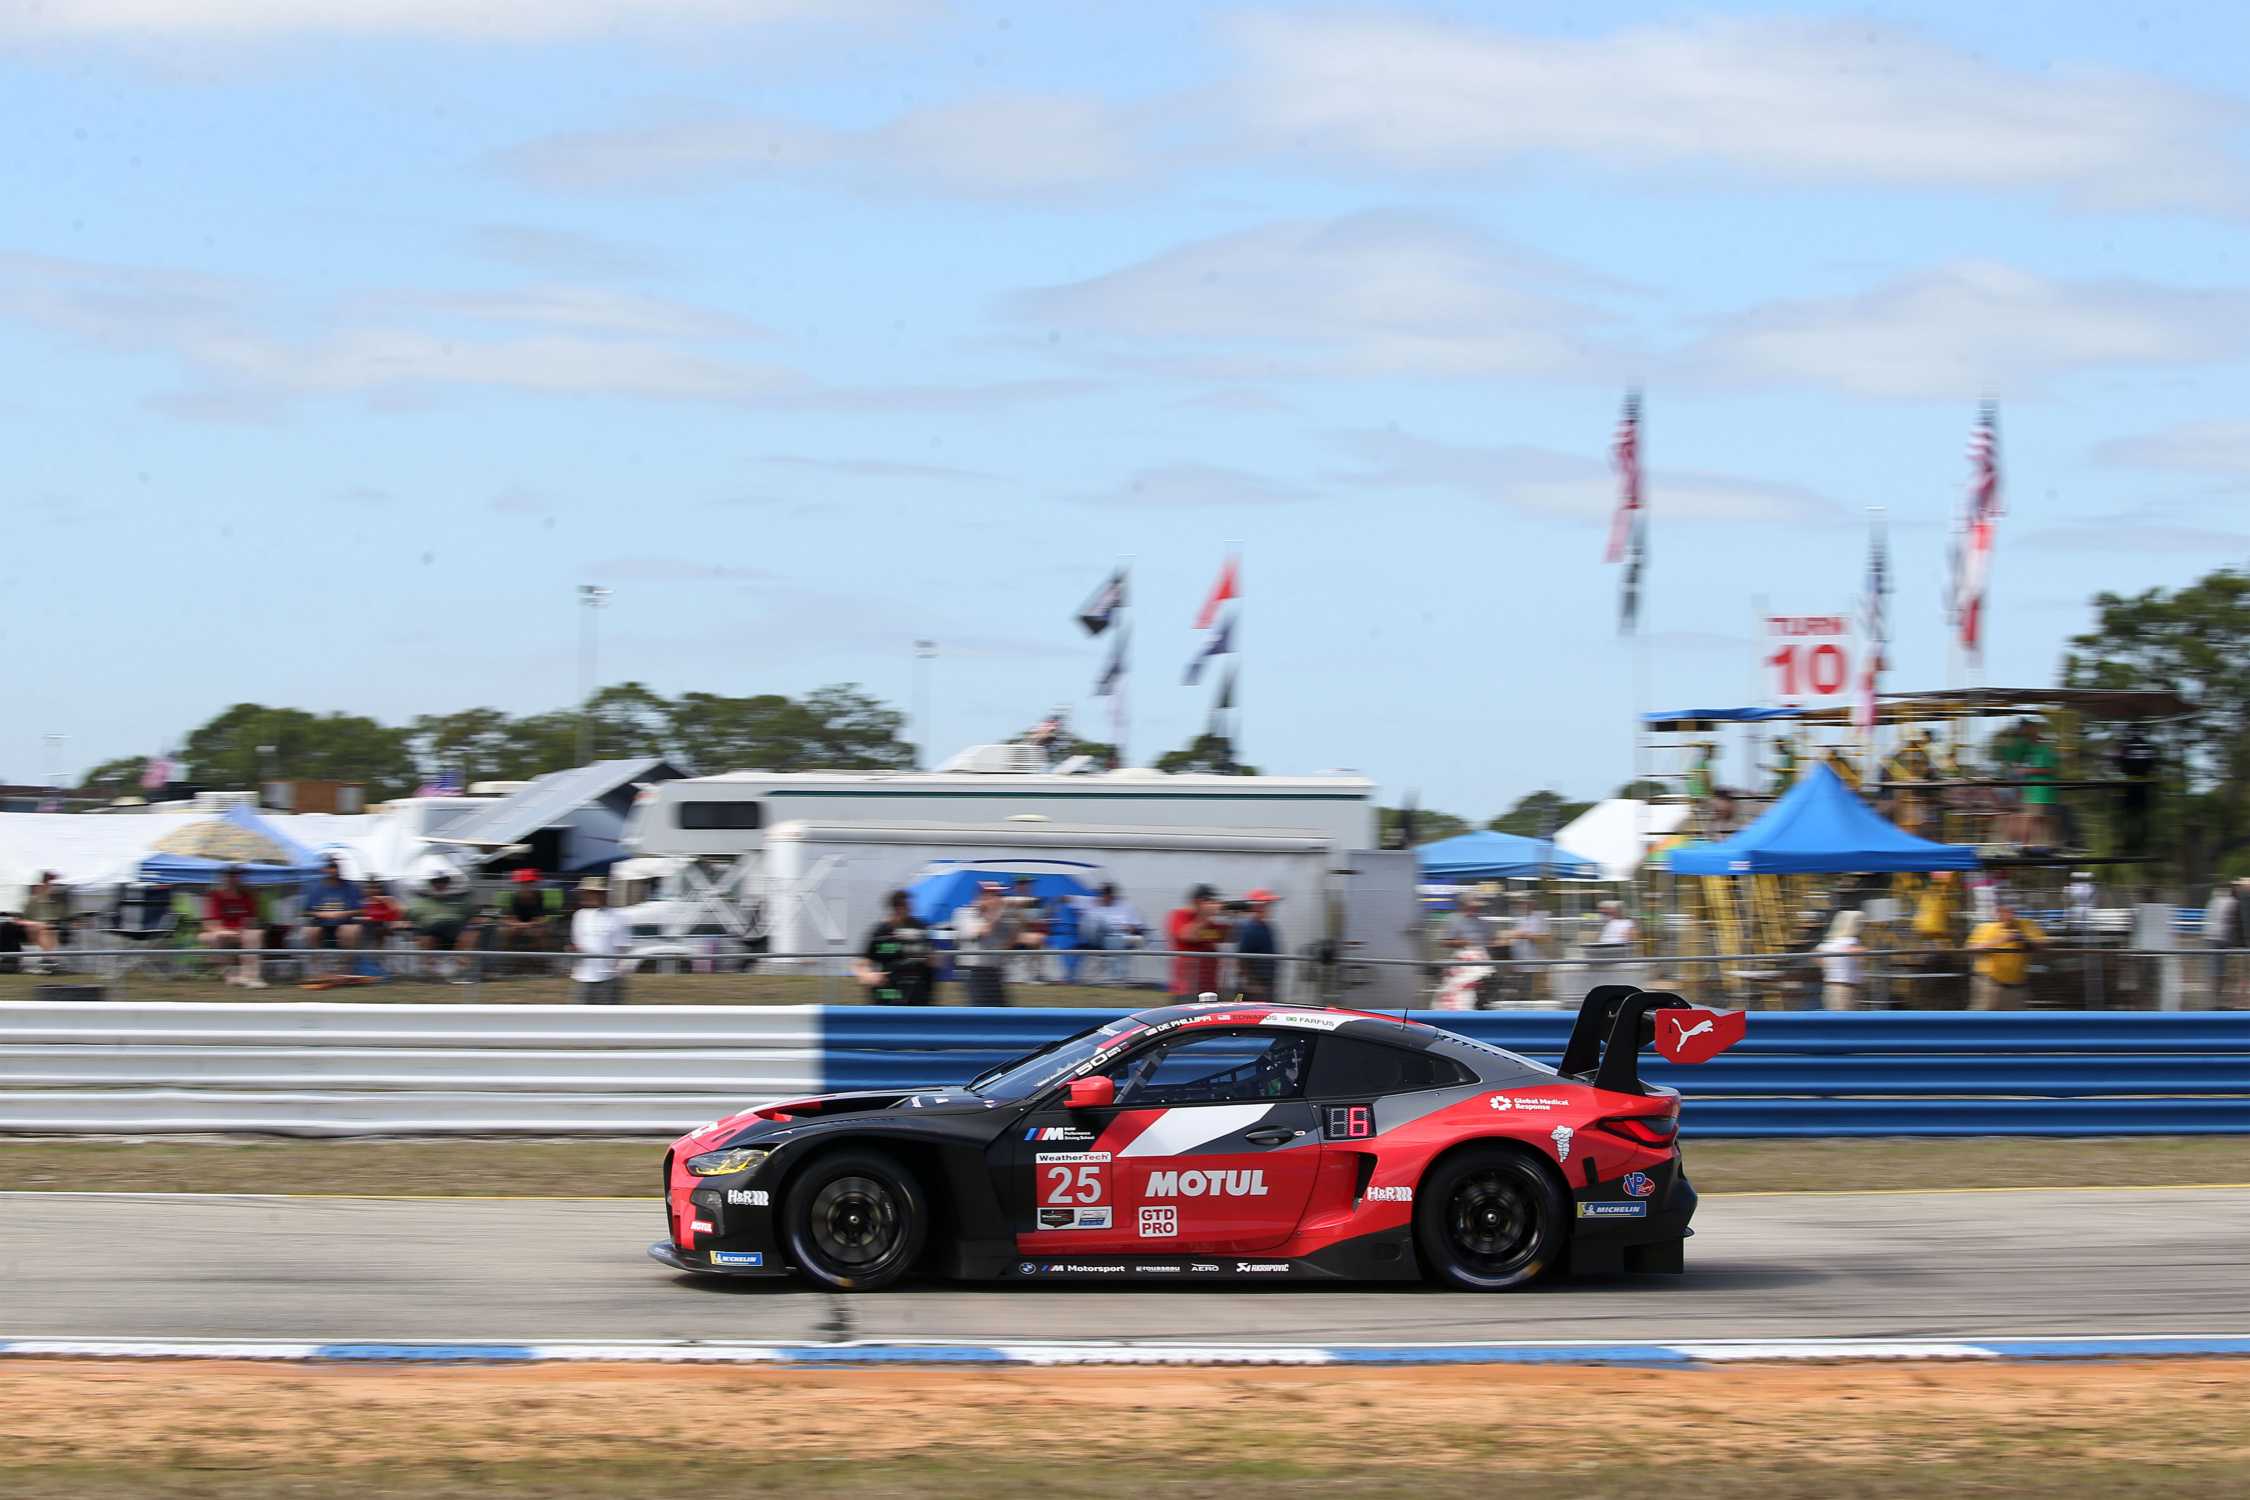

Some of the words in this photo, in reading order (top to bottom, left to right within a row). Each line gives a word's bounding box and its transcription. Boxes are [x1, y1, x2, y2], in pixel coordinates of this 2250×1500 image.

[1768, 617, 1847, 635] TURN
[1767, 644, 1848, 694] 10
[1158, 1023, 1171, 1032] DE
[1300, 1017, 1334, 1027] FARFUS
[1040, 1153, 1108, 1162] WeatherTech
[1047, 1166, 1102, 1204] 25
[1145, 1170, 1269, 1197] MOTUL
[1141, 1209, 1175, 1220] GTD
[1142, 1222, 1175, 1234] PRO
[1067, 1265, 1126, 1273] Motorsport
